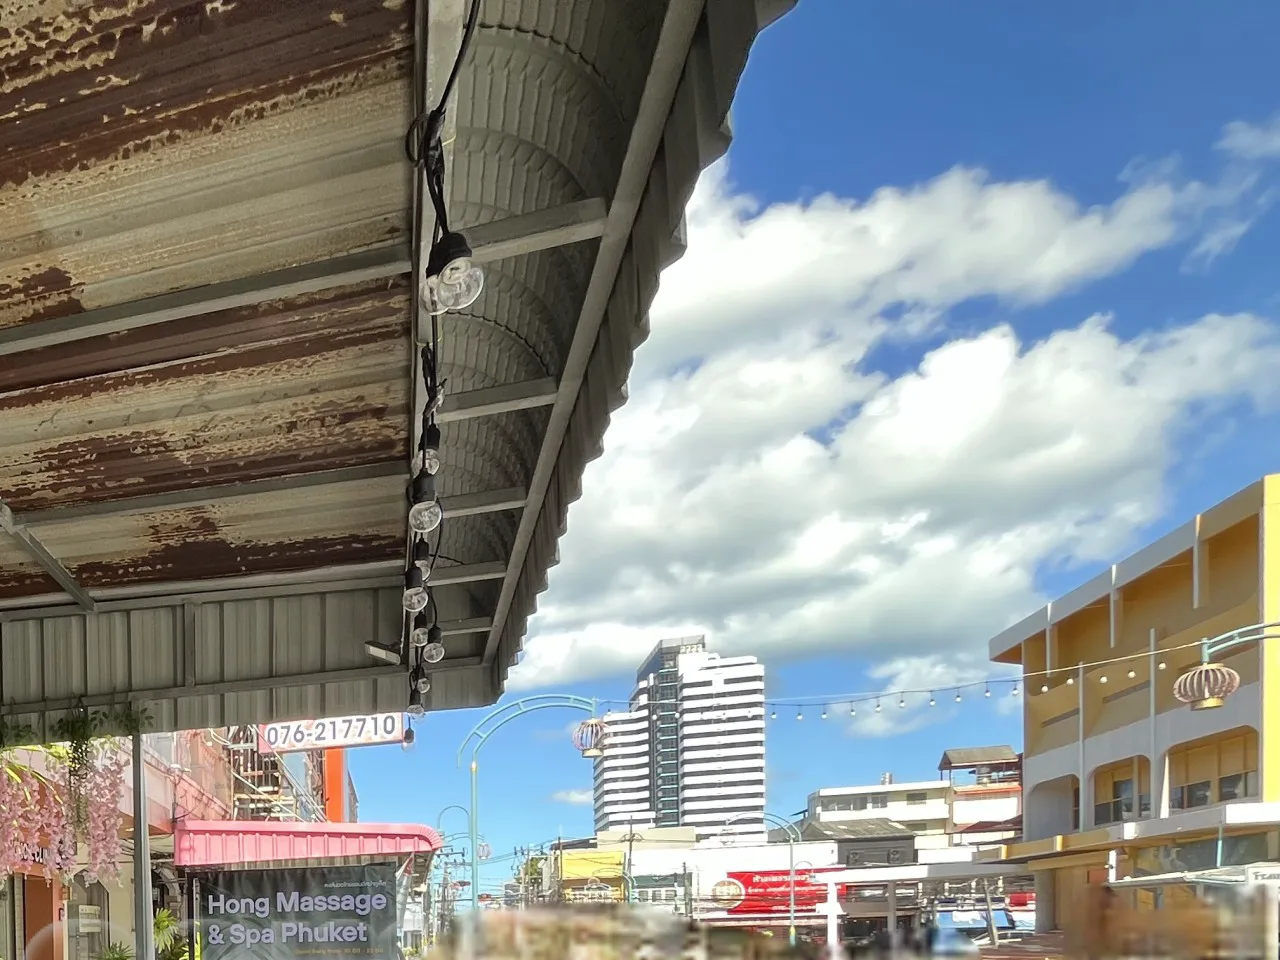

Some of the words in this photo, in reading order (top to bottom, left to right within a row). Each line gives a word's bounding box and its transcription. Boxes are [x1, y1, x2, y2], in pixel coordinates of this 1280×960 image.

[267, 715, 396, 746] 076-217710
[208, 894, 269, 918] Hong
[276, 891, 387, 915] Massage
[208, 924, 225, 945] &
[229, 924, 275, 948] Spa
[282, 921, 367, 943] Phuket
